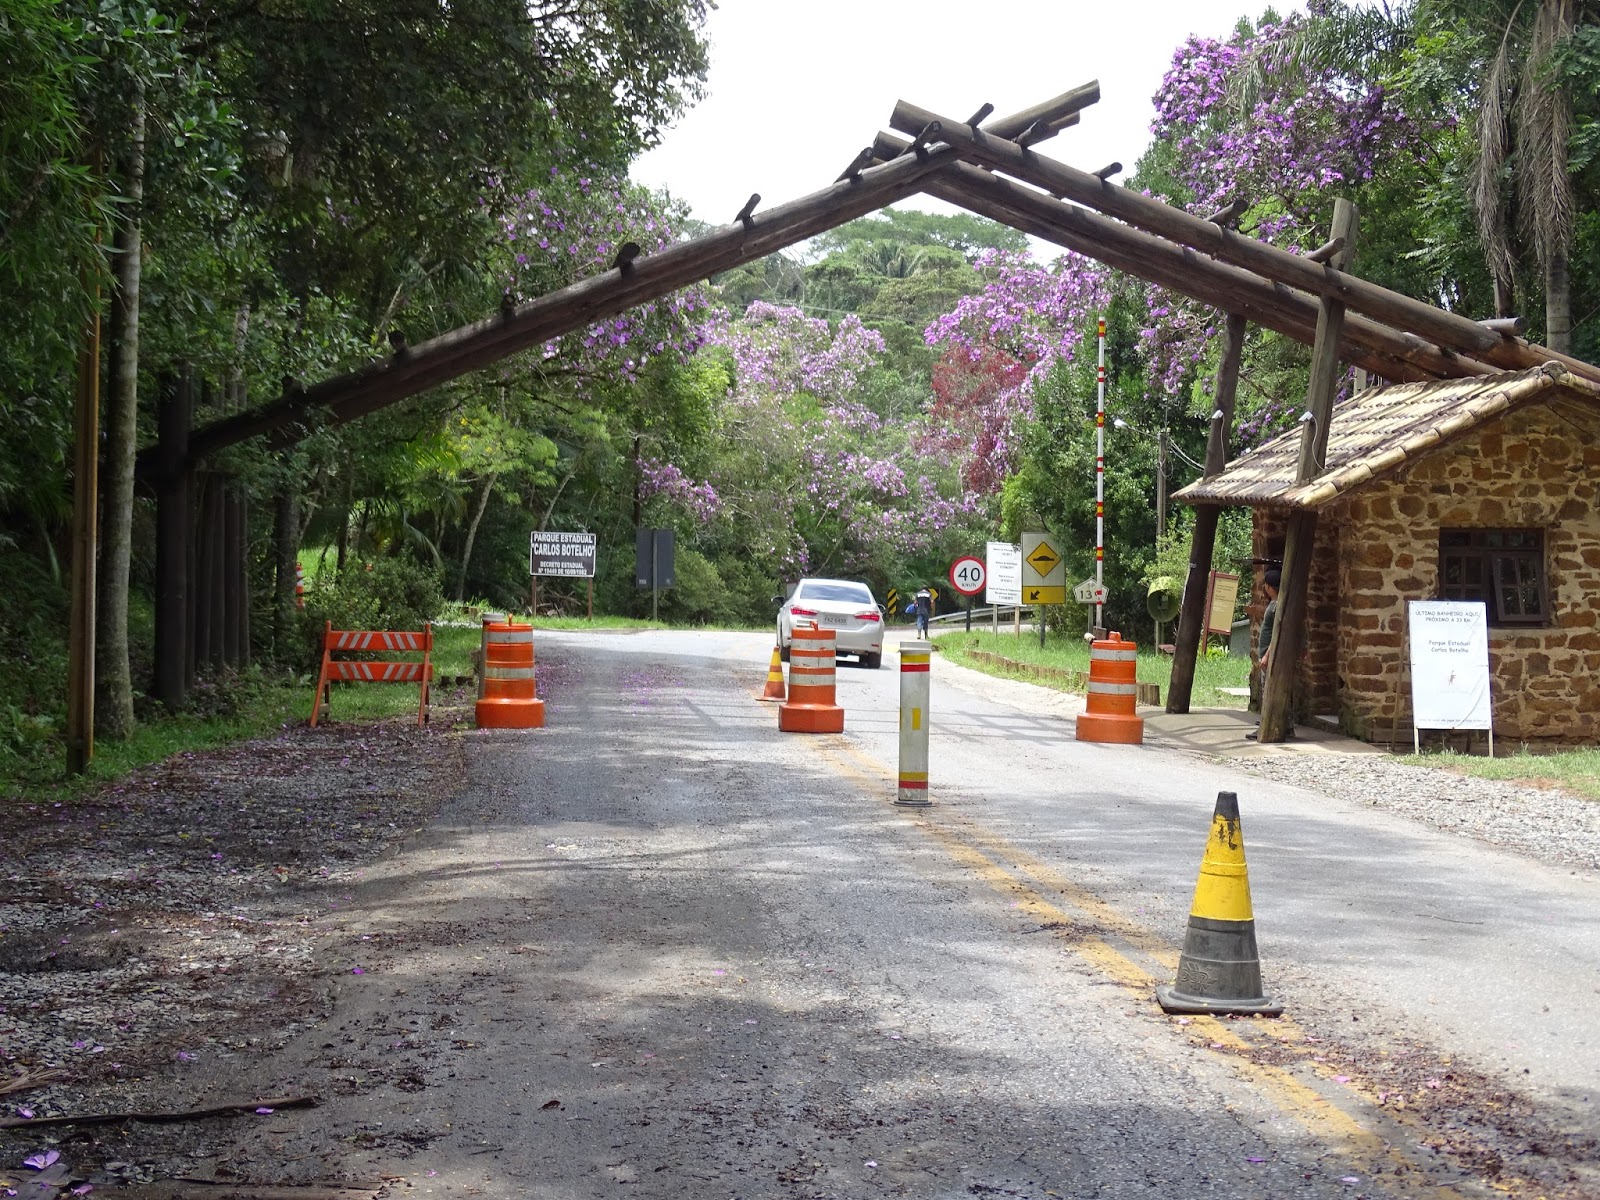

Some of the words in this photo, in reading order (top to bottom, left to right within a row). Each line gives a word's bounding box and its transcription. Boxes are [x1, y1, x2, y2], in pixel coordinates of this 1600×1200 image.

[533, 533, 560, 543] PARQUE
[560, 534, 593, 544] ESTADUAL
[957, 567, 980, 581] 40
